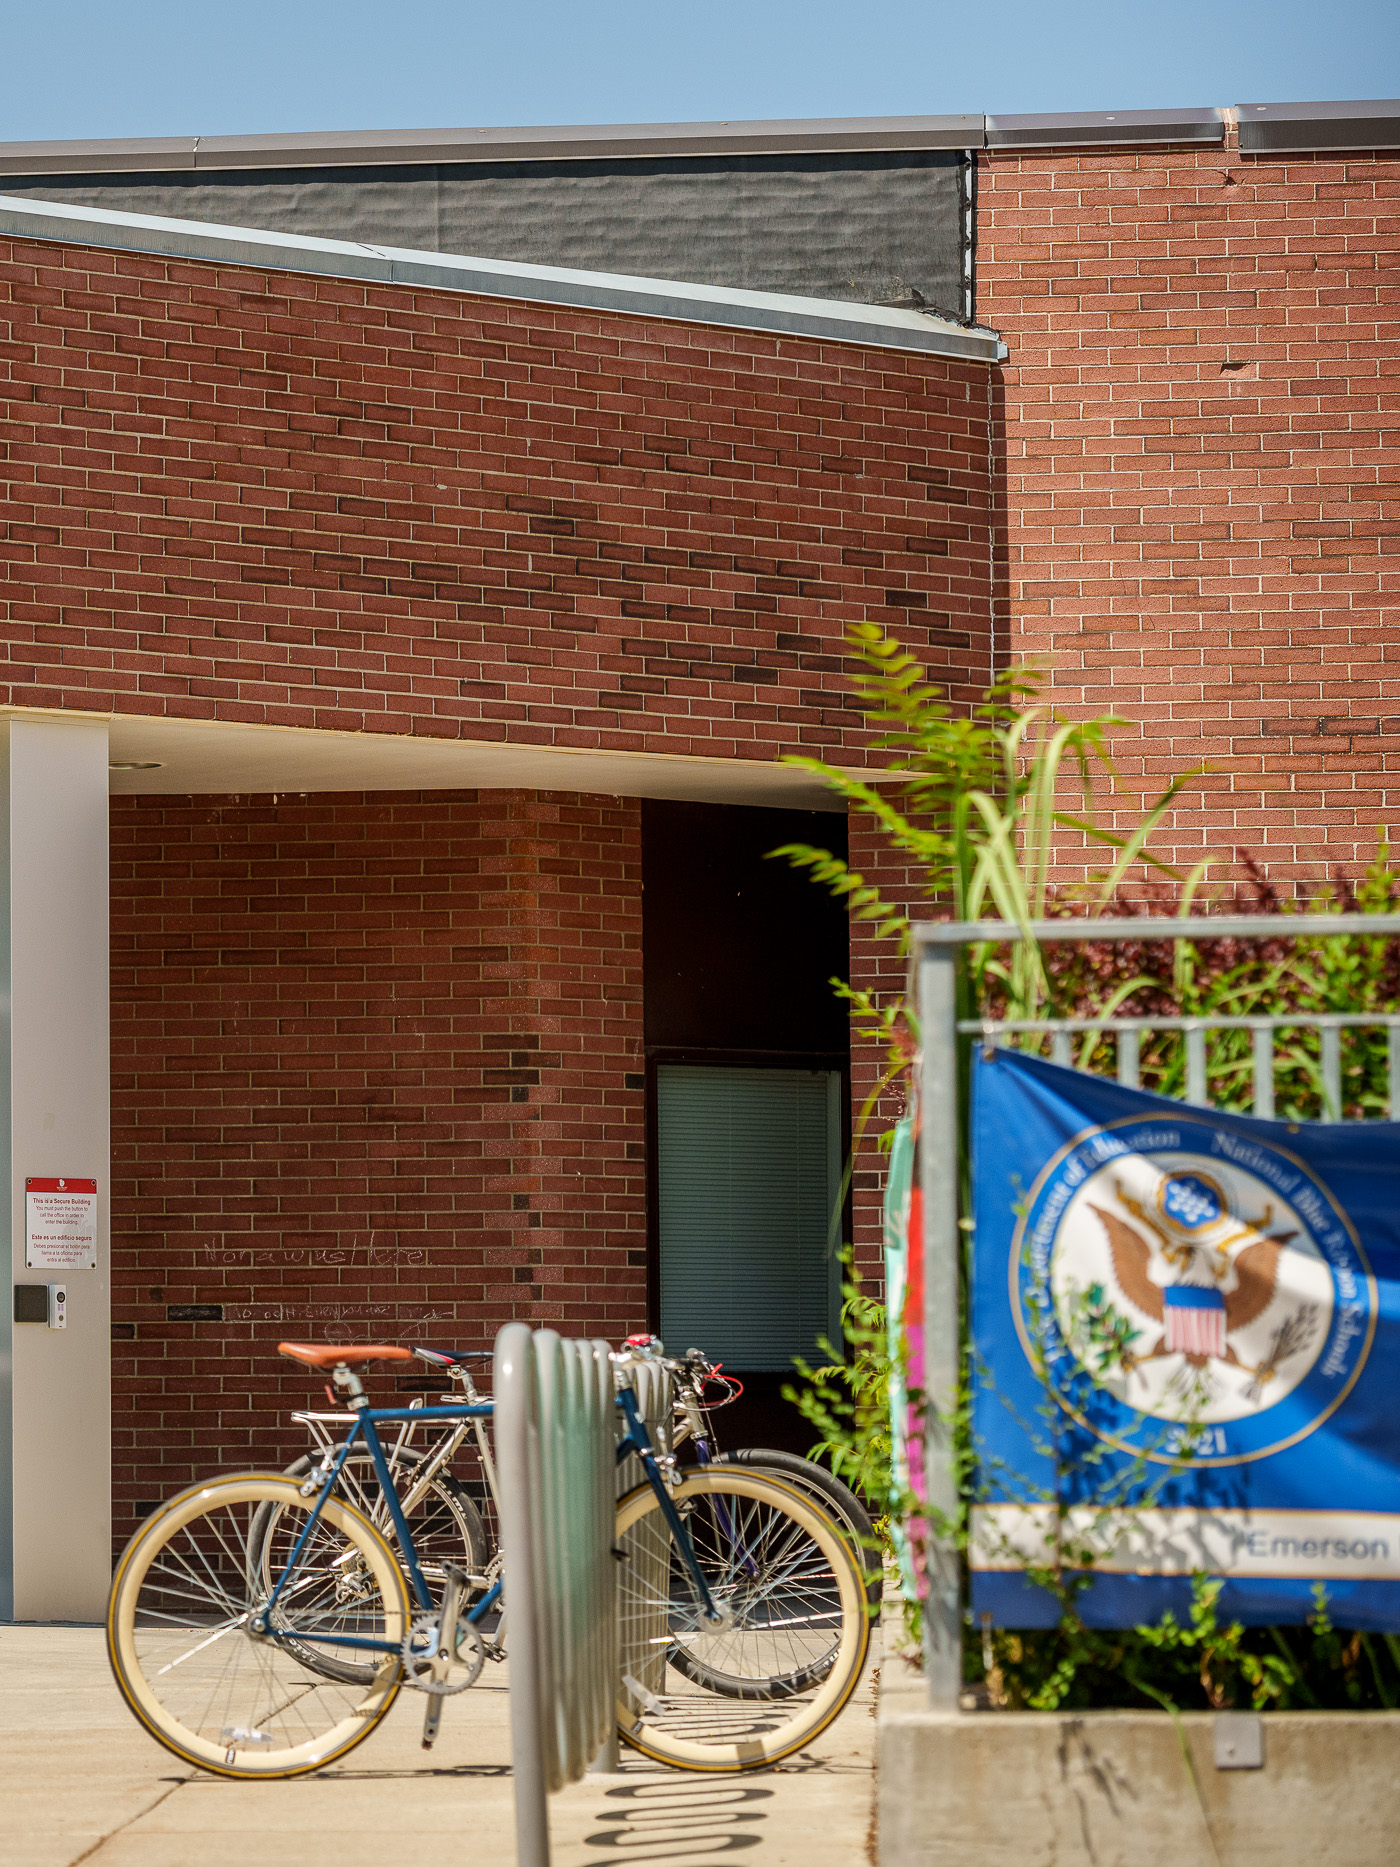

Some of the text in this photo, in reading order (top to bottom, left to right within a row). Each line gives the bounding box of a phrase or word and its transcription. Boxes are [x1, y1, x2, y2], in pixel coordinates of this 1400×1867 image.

[1210, 1130, 1301, 1194] National
[1292, 1185, 1331, 1233] Blue
[1320, 1301, 1364, 1378] Schools
[1165, 1427, 1228, 1455] 221
[1246, 1528, 1391, 1561] Emerson
